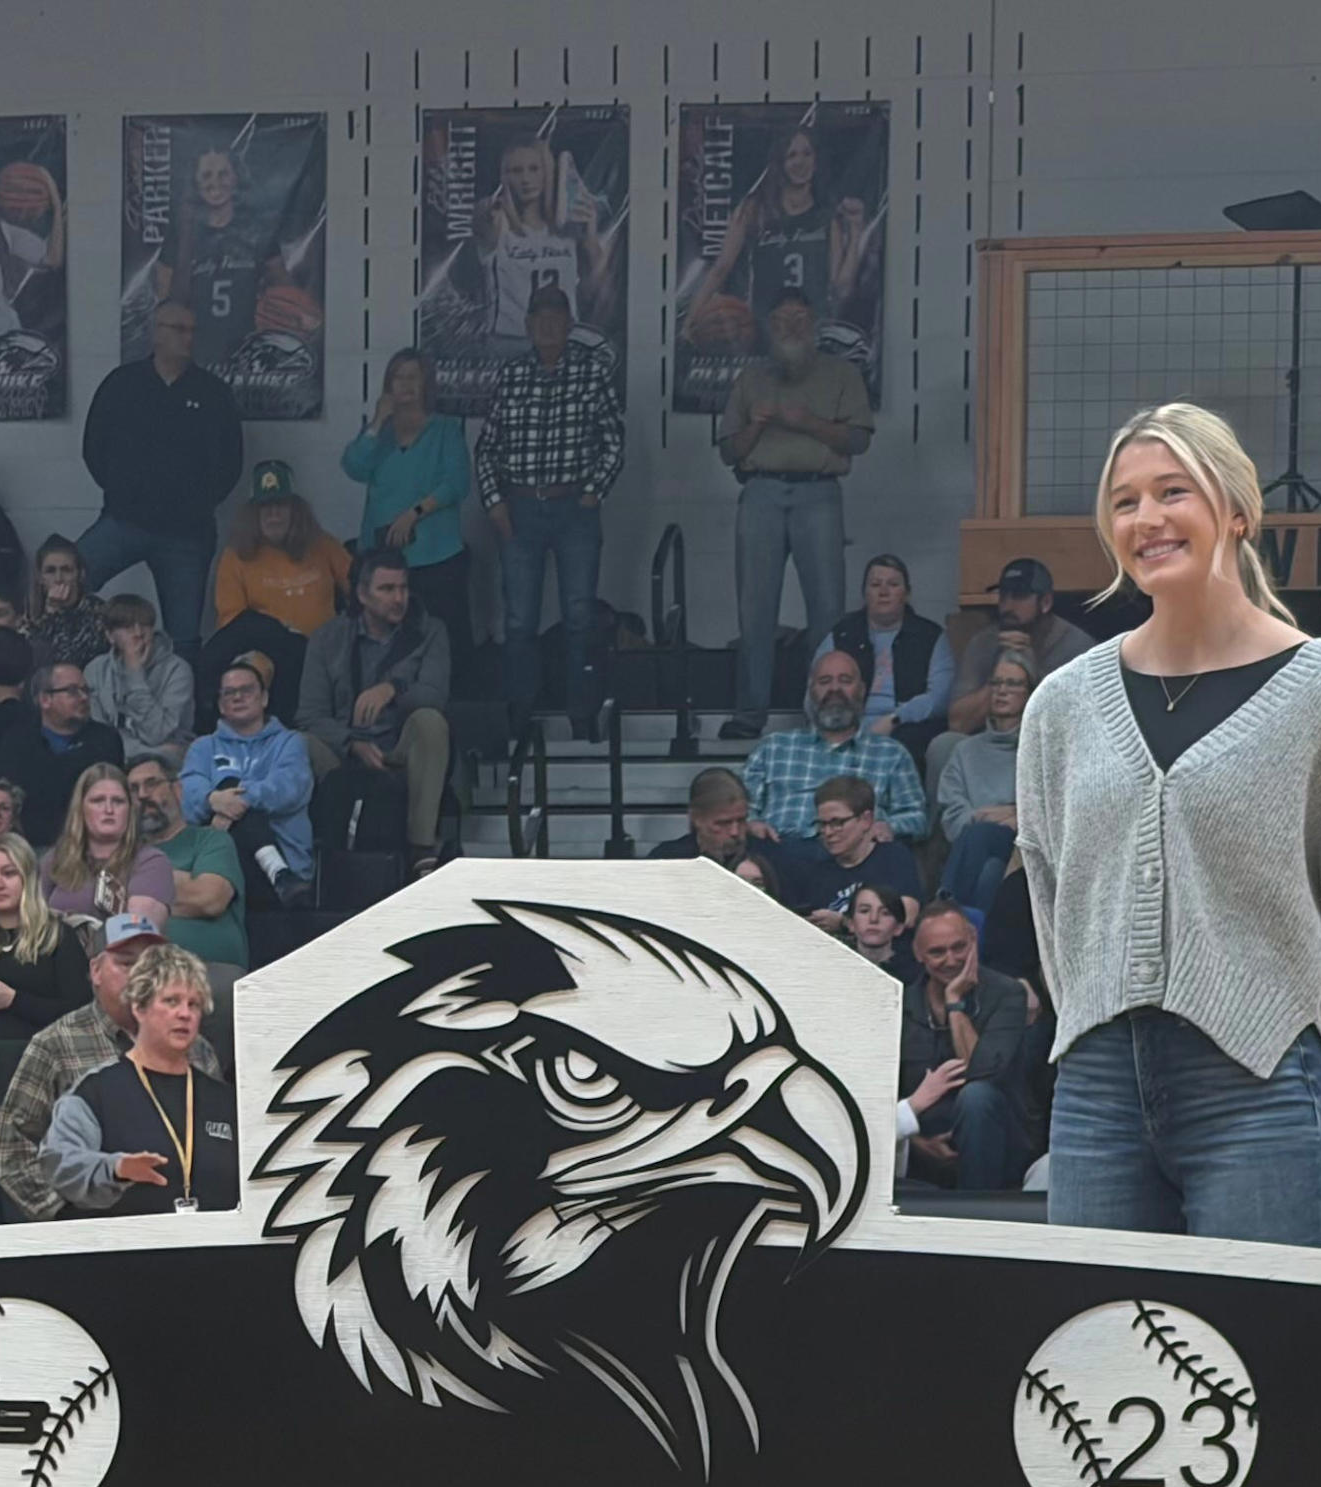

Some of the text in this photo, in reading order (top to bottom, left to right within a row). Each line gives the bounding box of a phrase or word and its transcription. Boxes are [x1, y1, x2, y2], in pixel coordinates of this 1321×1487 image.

[143, 124, 172, 245] PARKER
[447, 121, 477, 241] WRIGHT
[701, 115, 733, 258] METCALF
[211, 280, 233, 317] 5
[783, 253, 804, 288] 3
